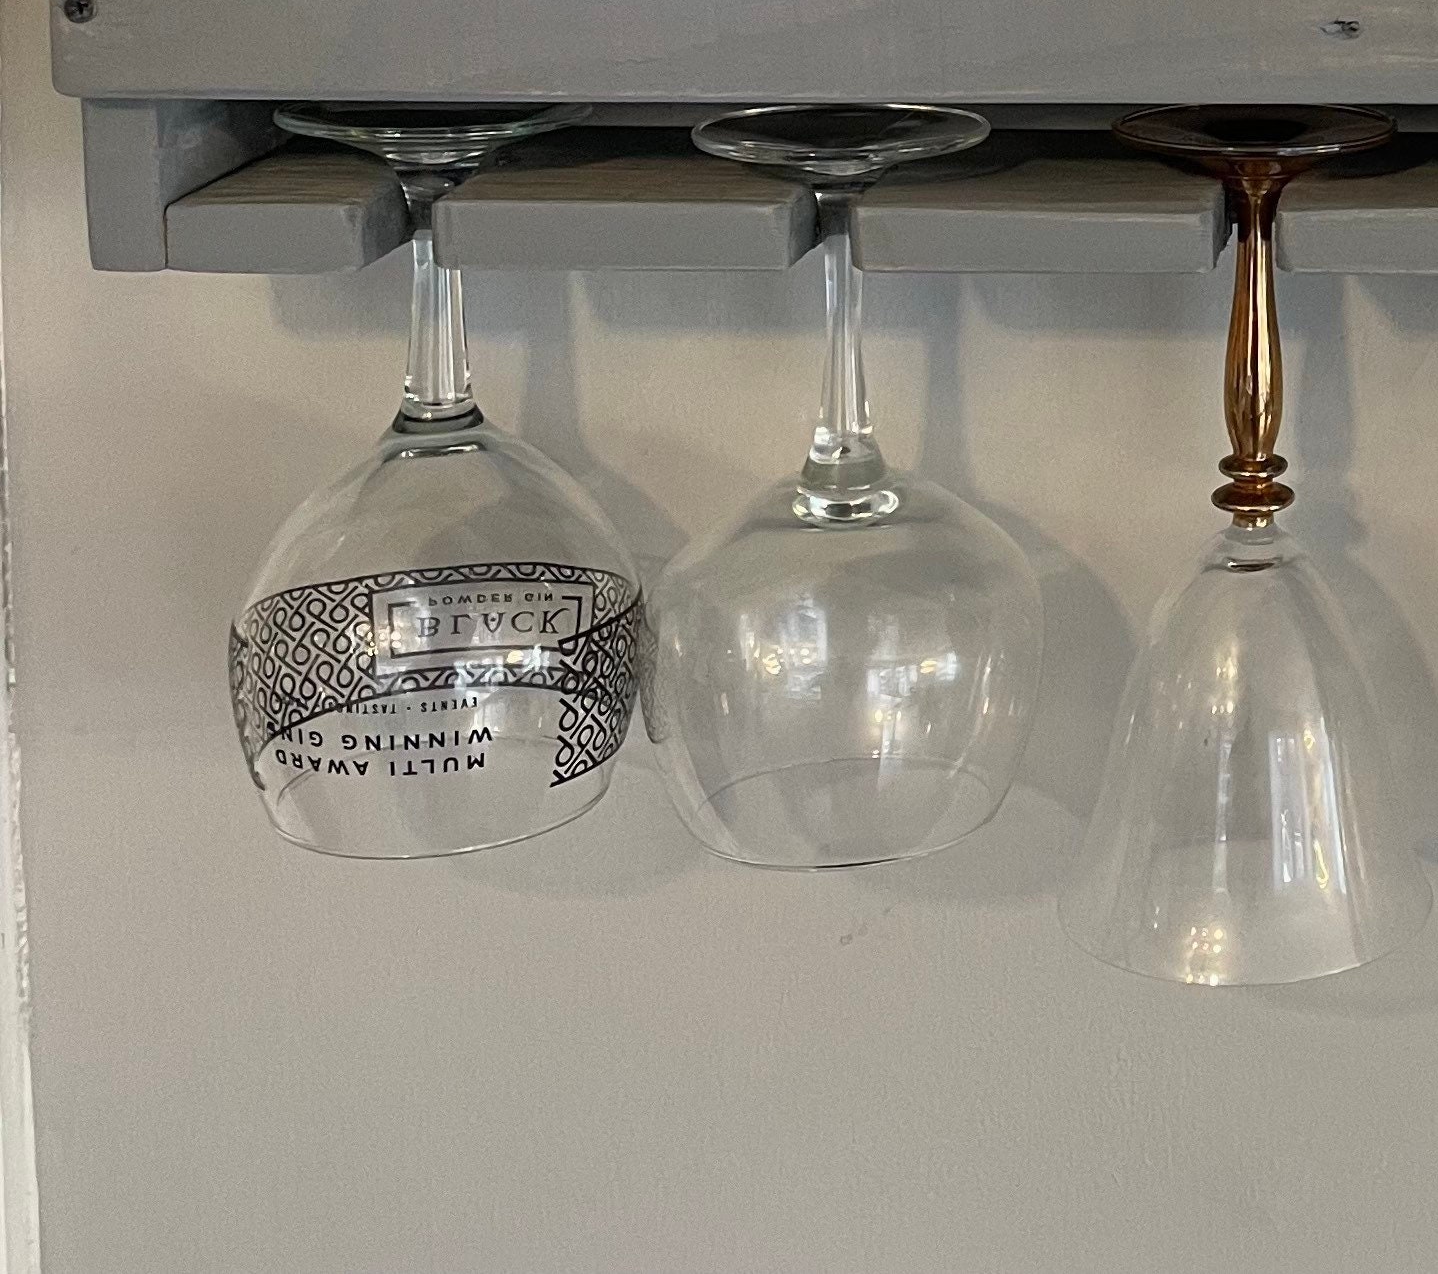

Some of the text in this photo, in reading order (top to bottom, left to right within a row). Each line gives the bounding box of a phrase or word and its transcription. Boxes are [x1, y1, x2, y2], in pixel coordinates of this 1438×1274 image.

[421, 697, 478, 713] EVENTS
[341, 726, 492, 751] WINNING
[275, 749, 485, 776] MULTI AWARD
